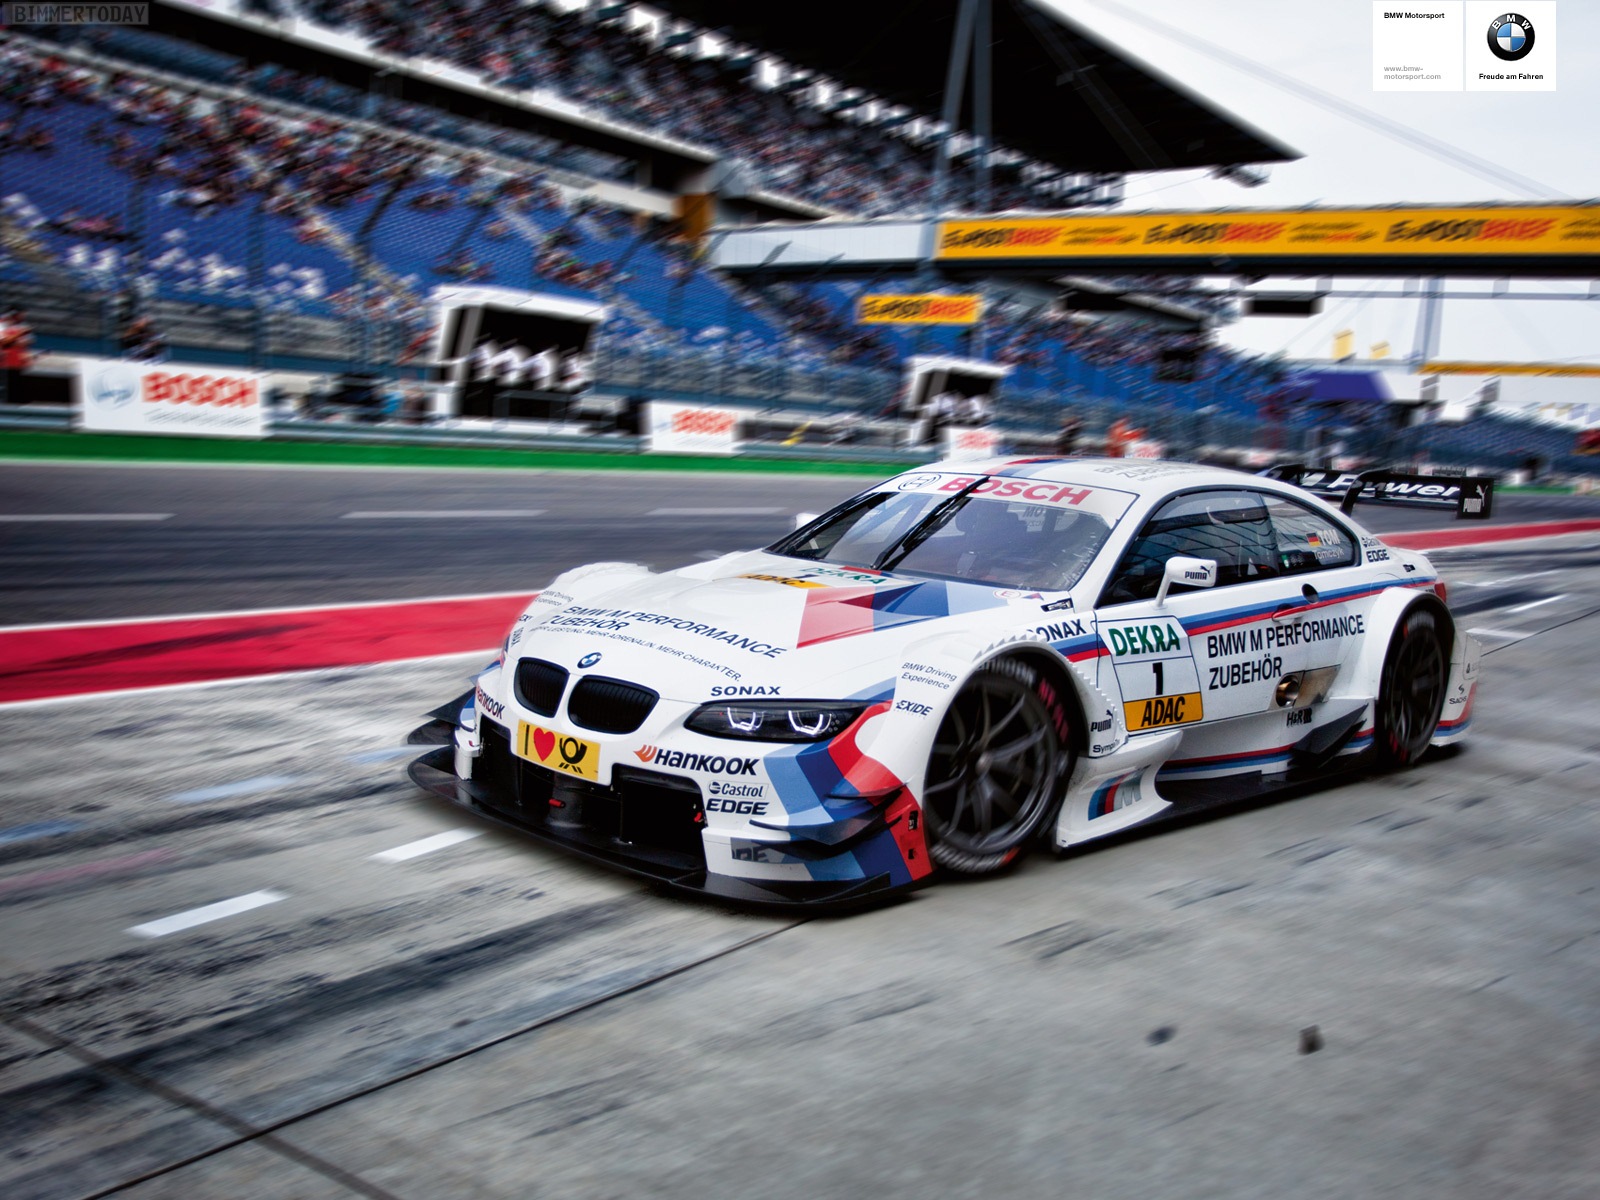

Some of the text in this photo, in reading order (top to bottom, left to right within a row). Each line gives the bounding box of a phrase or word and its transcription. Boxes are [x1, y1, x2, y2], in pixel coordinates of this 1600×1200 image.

[141, 371, 259, 408] BOSCH
[938, 477, 1093, 505] BOSCH
[1327, 474, 1460, 497] Pwer
[1317, 529, 1340, 546] TOM
[1366, 549, 1390, 562] EDGE
[1184, 571, 1208, 580] PUMA
[563, 606, 612, 618] BMW
[629, 611, 787, 659] PERFORMANCE
[1027, 618, 1087, 642] ONAX
[1108, 623, 1180, 656] DEKRA
[1207, 614, 1365, 658] BMW M PERFORMANCE
[656, 645, 684, 657] MEHR
[683, 654, 741, 682] CHARAKTER.
[901, 662, 957, 682] BMW Driving
[1209, 653, 1282, 690] ZUBEHÖR
[901, 672, 950, 689] Experience
[1153, 662, 1164, 696] 1
[711, 686, 781, 696] SONAX
[896, 700, 933, 716] EXIDE
[1141, 696, 1186, 727] ADAC
[721, 782, 764, 798] Castrol
[706, 798, 770, 815] EDGE
